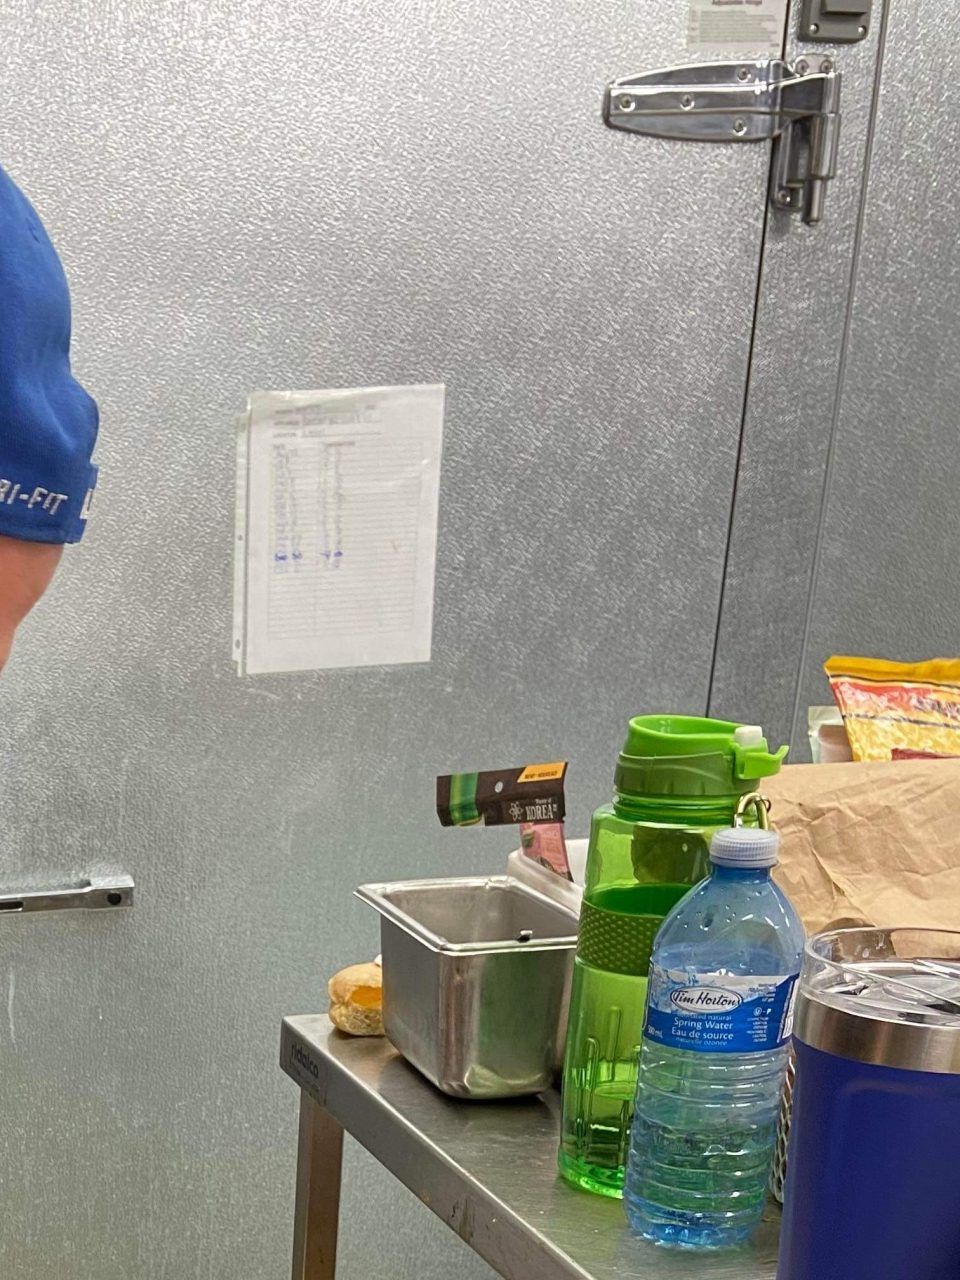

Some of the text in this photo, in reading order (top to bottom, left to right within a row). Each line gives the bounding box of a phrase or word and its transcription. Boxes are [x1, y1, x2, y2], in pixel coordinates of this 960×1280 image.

[525, 804, 554, 820] KOREA
[673, 990, 694, 1004] Tim
[674, 1016, 702, 1030] Spring
[705, 1020, 734, 1030] Water
[671, 1026, 734, 1040] Eau de source
